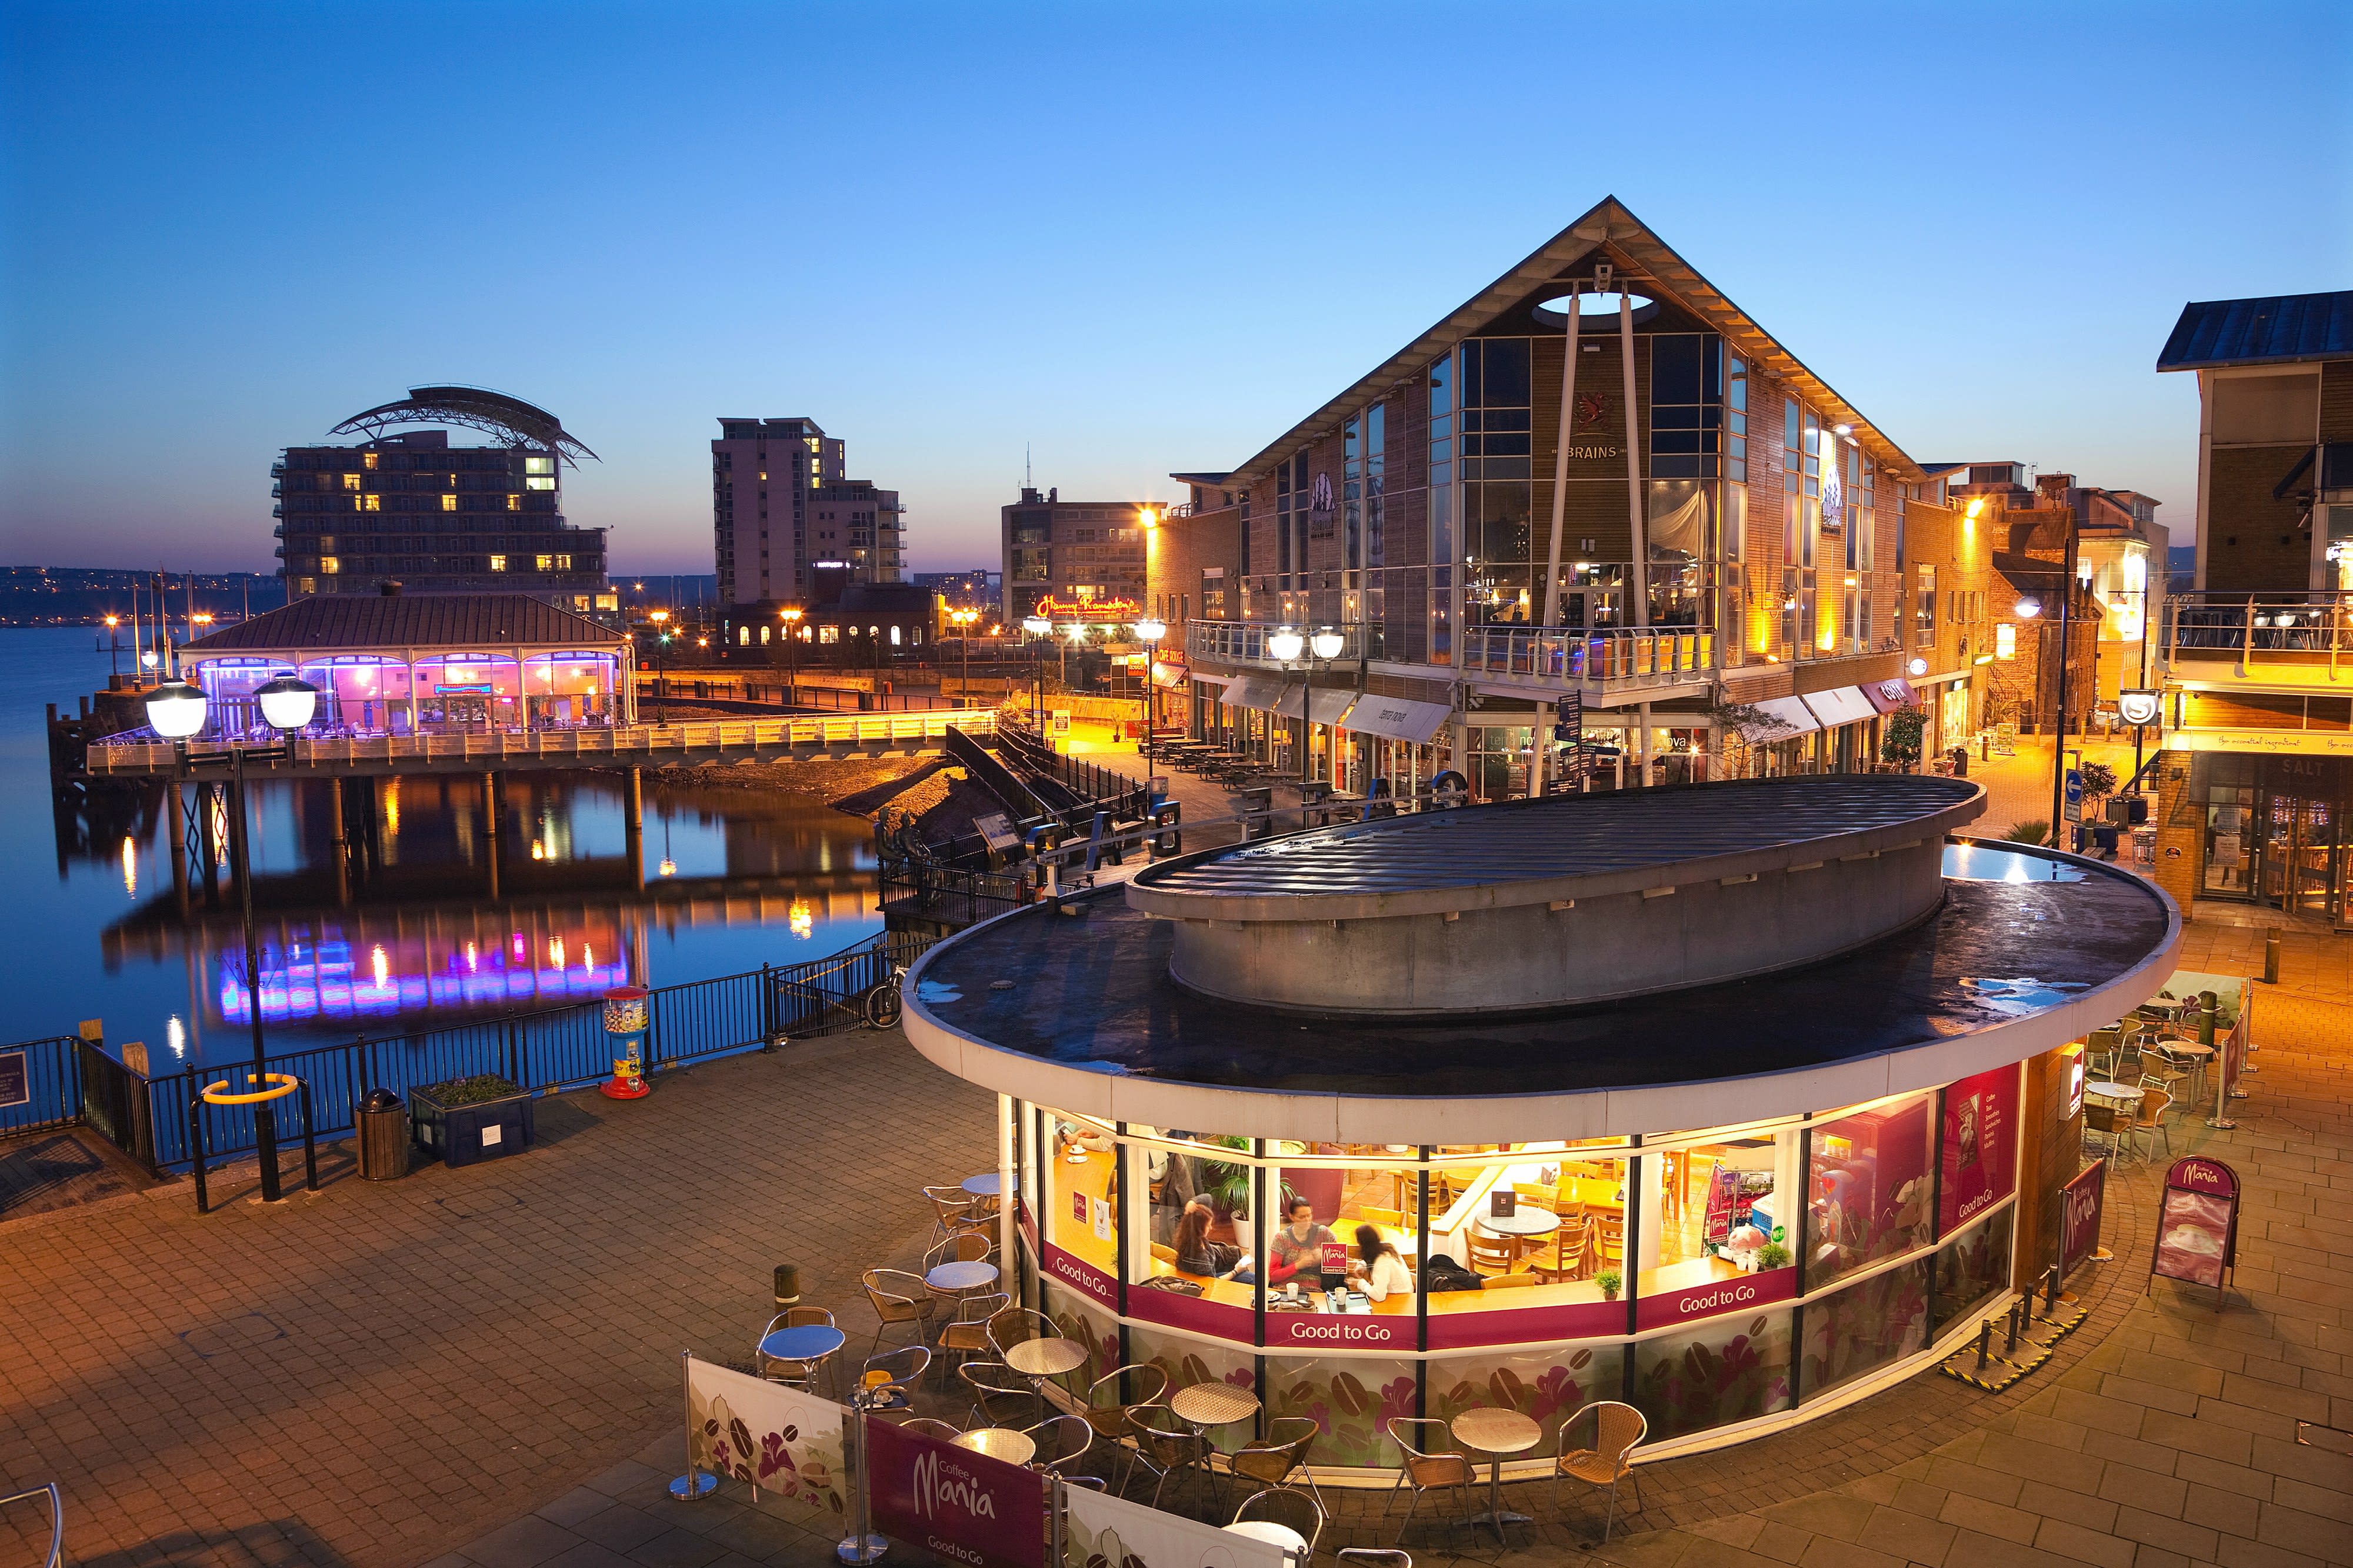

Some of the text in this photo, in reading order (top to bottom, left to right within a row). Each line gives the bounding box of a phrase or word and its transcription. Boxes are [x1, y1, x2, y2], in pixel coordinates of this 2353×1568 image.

[1568, 446, 1617, 459] BRAINS
[1036, 595, 1135, 618] Harry Ramsden's
[1879, 683, 1907, 700] COSTA
[1379, 708, 1407, 722] terra nova
[2218, 735, 2301, 750] the essential ingredient
[2328, 739, 2339, 749] the
[2282, 758, 2324, 776] SALT
[2183, 1163, 2218, 1185] Mania
[1959, 1189, 1992, 1217] Good to Go
[1711, 1218, 1727, 1233] Mania
[2065, 1187, 2095, 1253] Mania
[1324, 1247, 1345, 1263] Mania
[1056, 1257, 1106, 1296] Good to Go
[1679, 1286, 1755, 1313] Good to Go
[1291, 1322, 1391, 1340] Good to Go
[939, 1460, 969, 1480] Coffee
[914, 1450, 995, 1520] Mania
[928, 1535, 983, 1565] Good to Go
